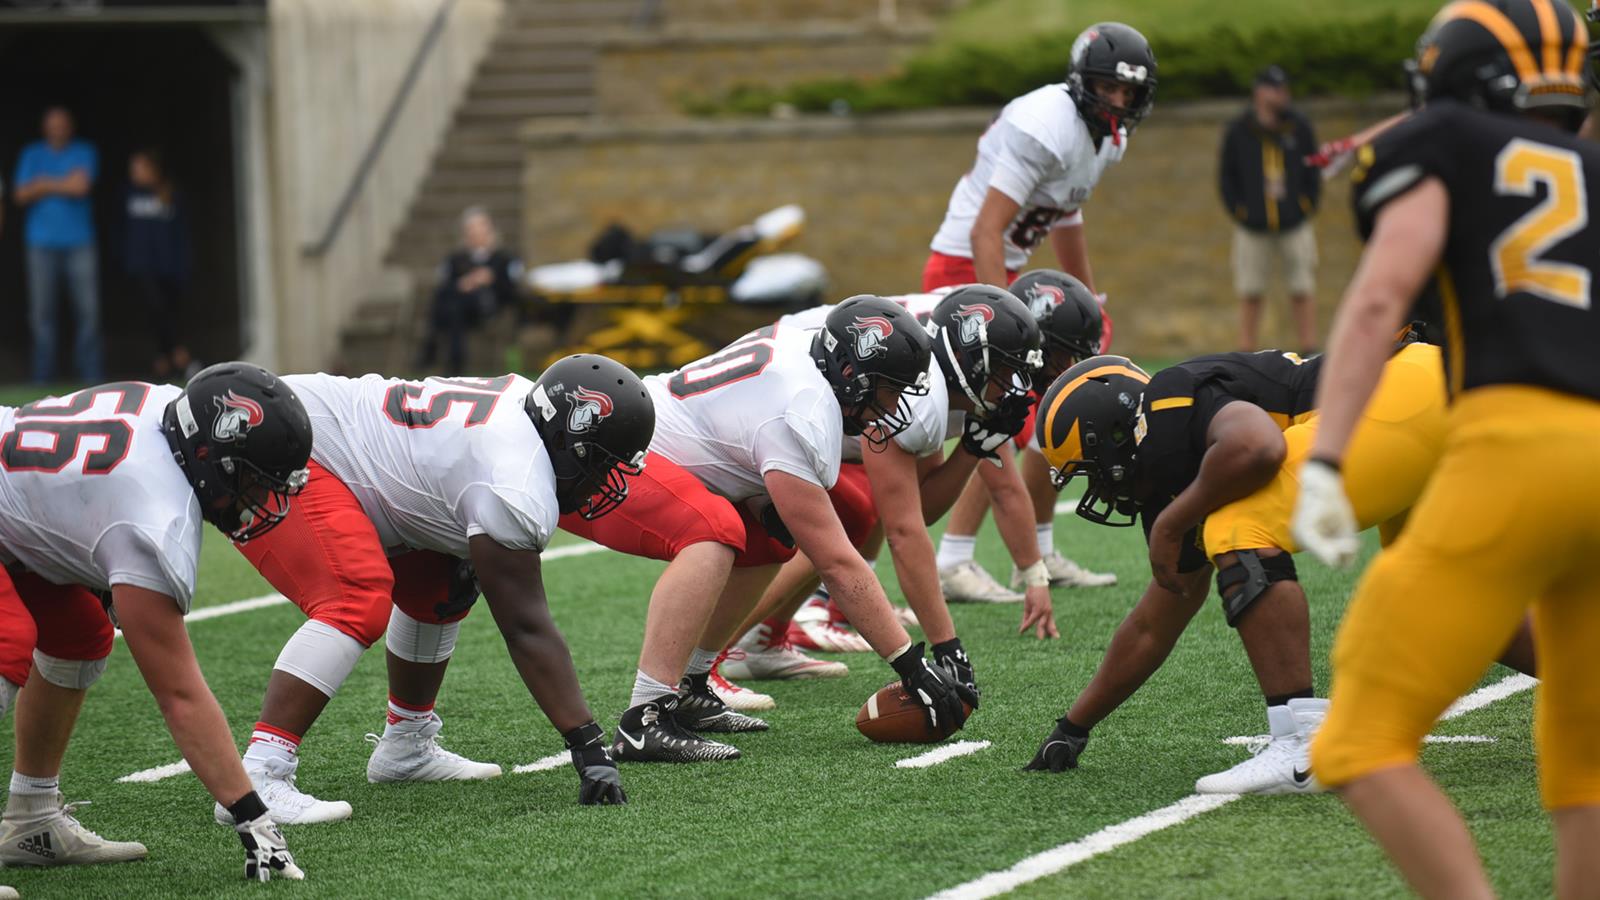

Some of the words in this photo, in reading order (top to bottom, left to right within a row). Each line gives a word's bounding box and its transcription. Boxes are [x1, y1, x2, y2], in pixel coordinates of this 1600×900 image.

[1488, 136, 1592, 310] 2
[0, 380, 151, 475] 56
[17, 840, 57, 860] adidas
